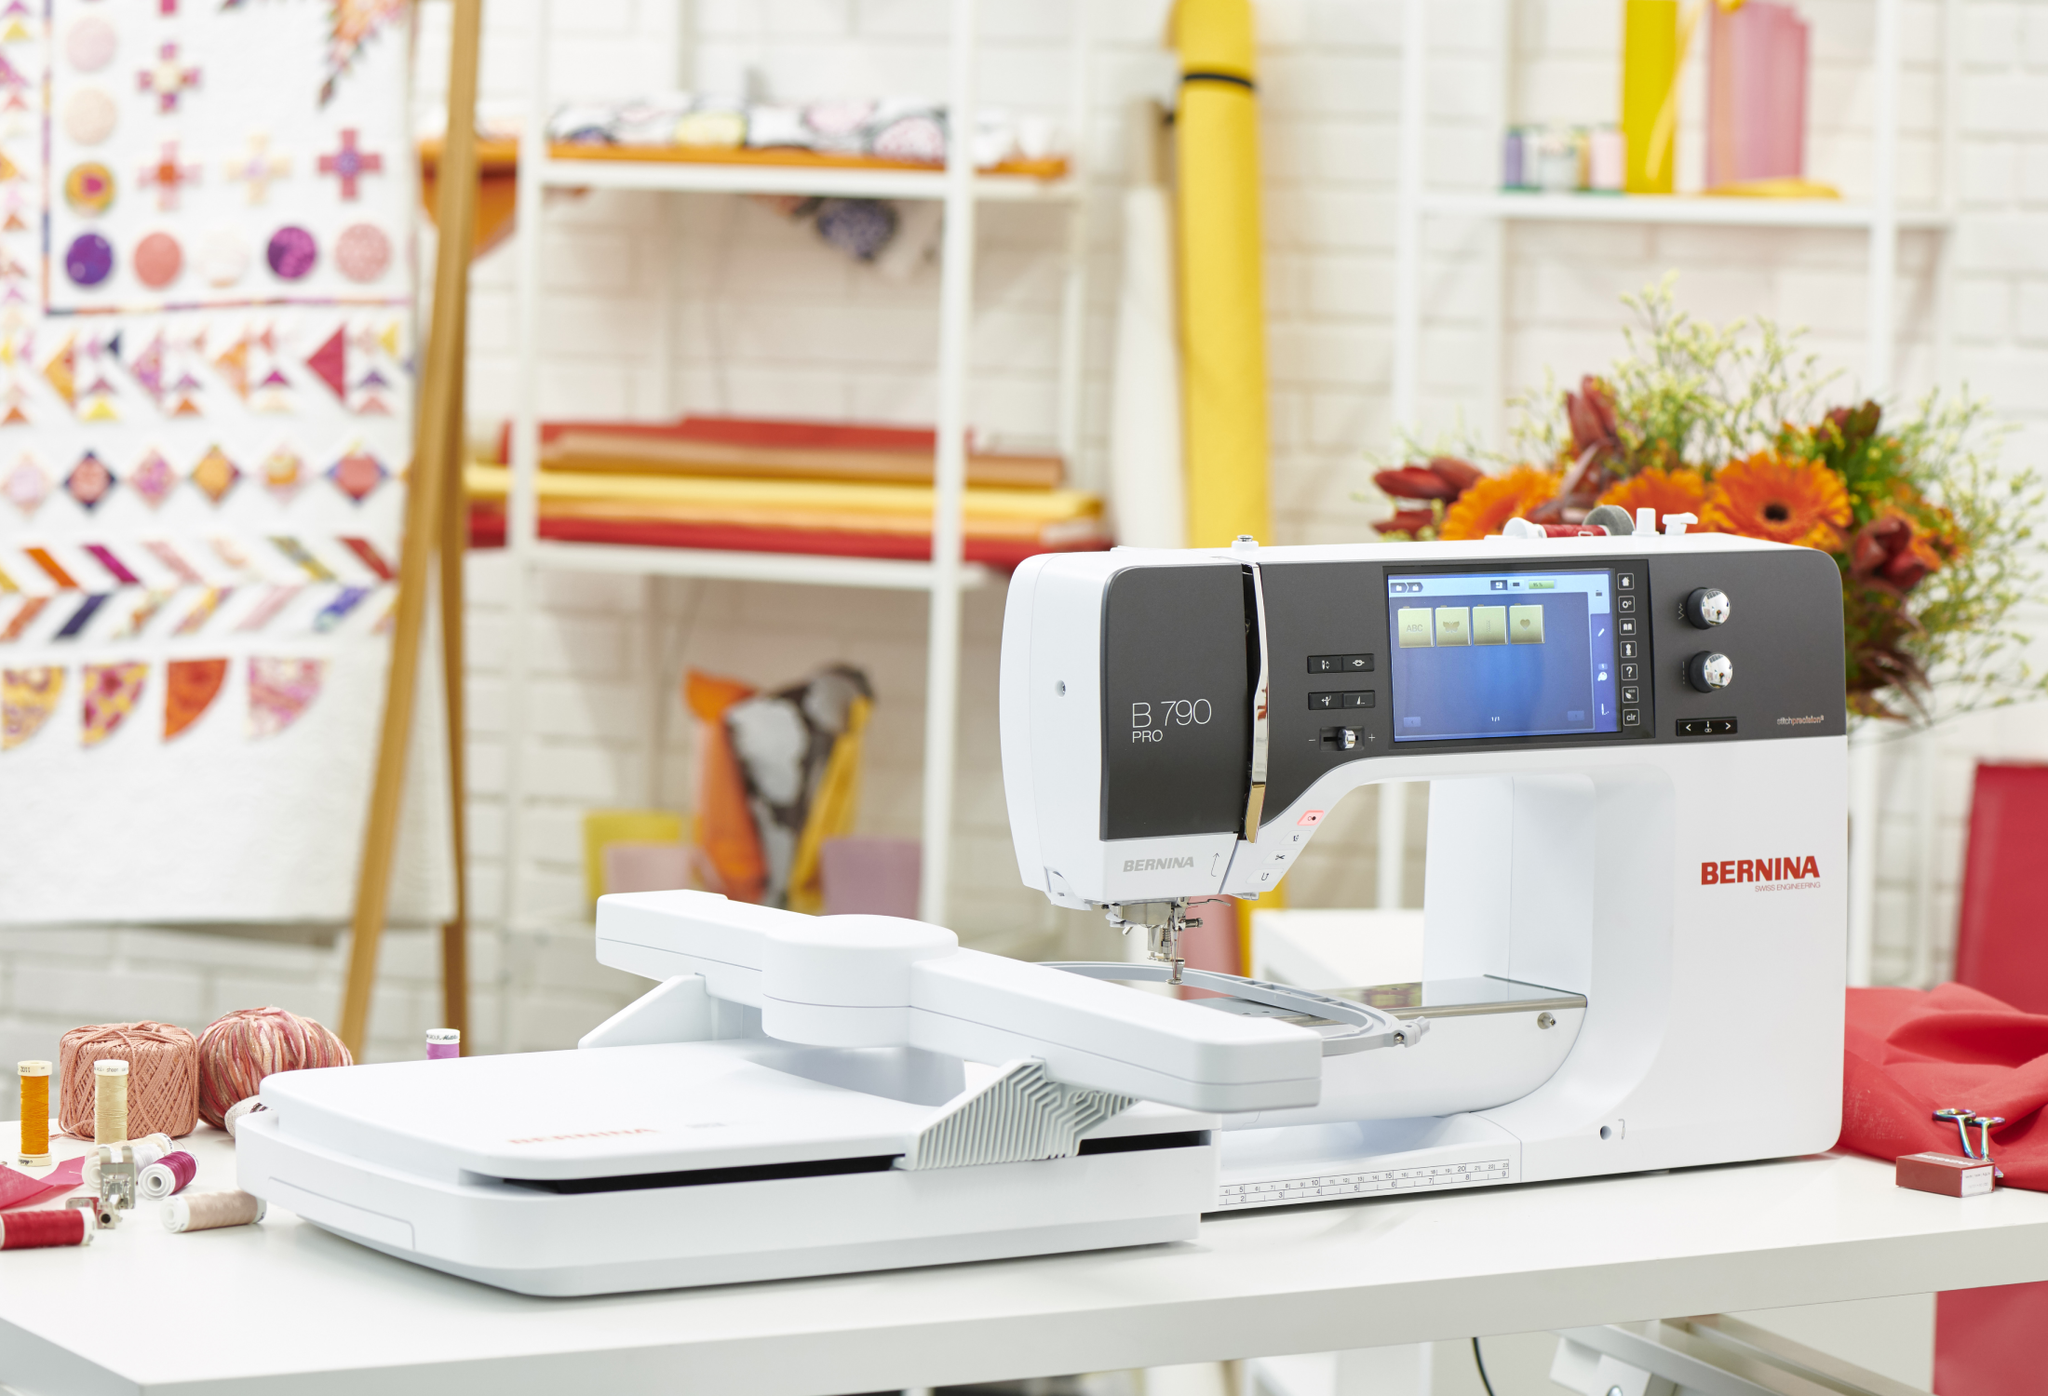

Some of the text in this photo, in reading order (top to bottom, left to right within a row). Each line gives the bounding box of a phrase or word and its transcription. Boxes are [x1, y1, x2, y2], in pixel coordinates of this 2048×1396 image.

[1406, 624, 1423, 633] ABC
[1132, 698, 1212, 728] B 790
[1626, 713, 1636, 721] clr
[1132, 729, 1163, 743] PRO
[1123, 856, 1194, 872] BERNINA
[1701, 855, 1821, 885] BERNINA
[1776, 881, 1821, 891] ENGINEERING
